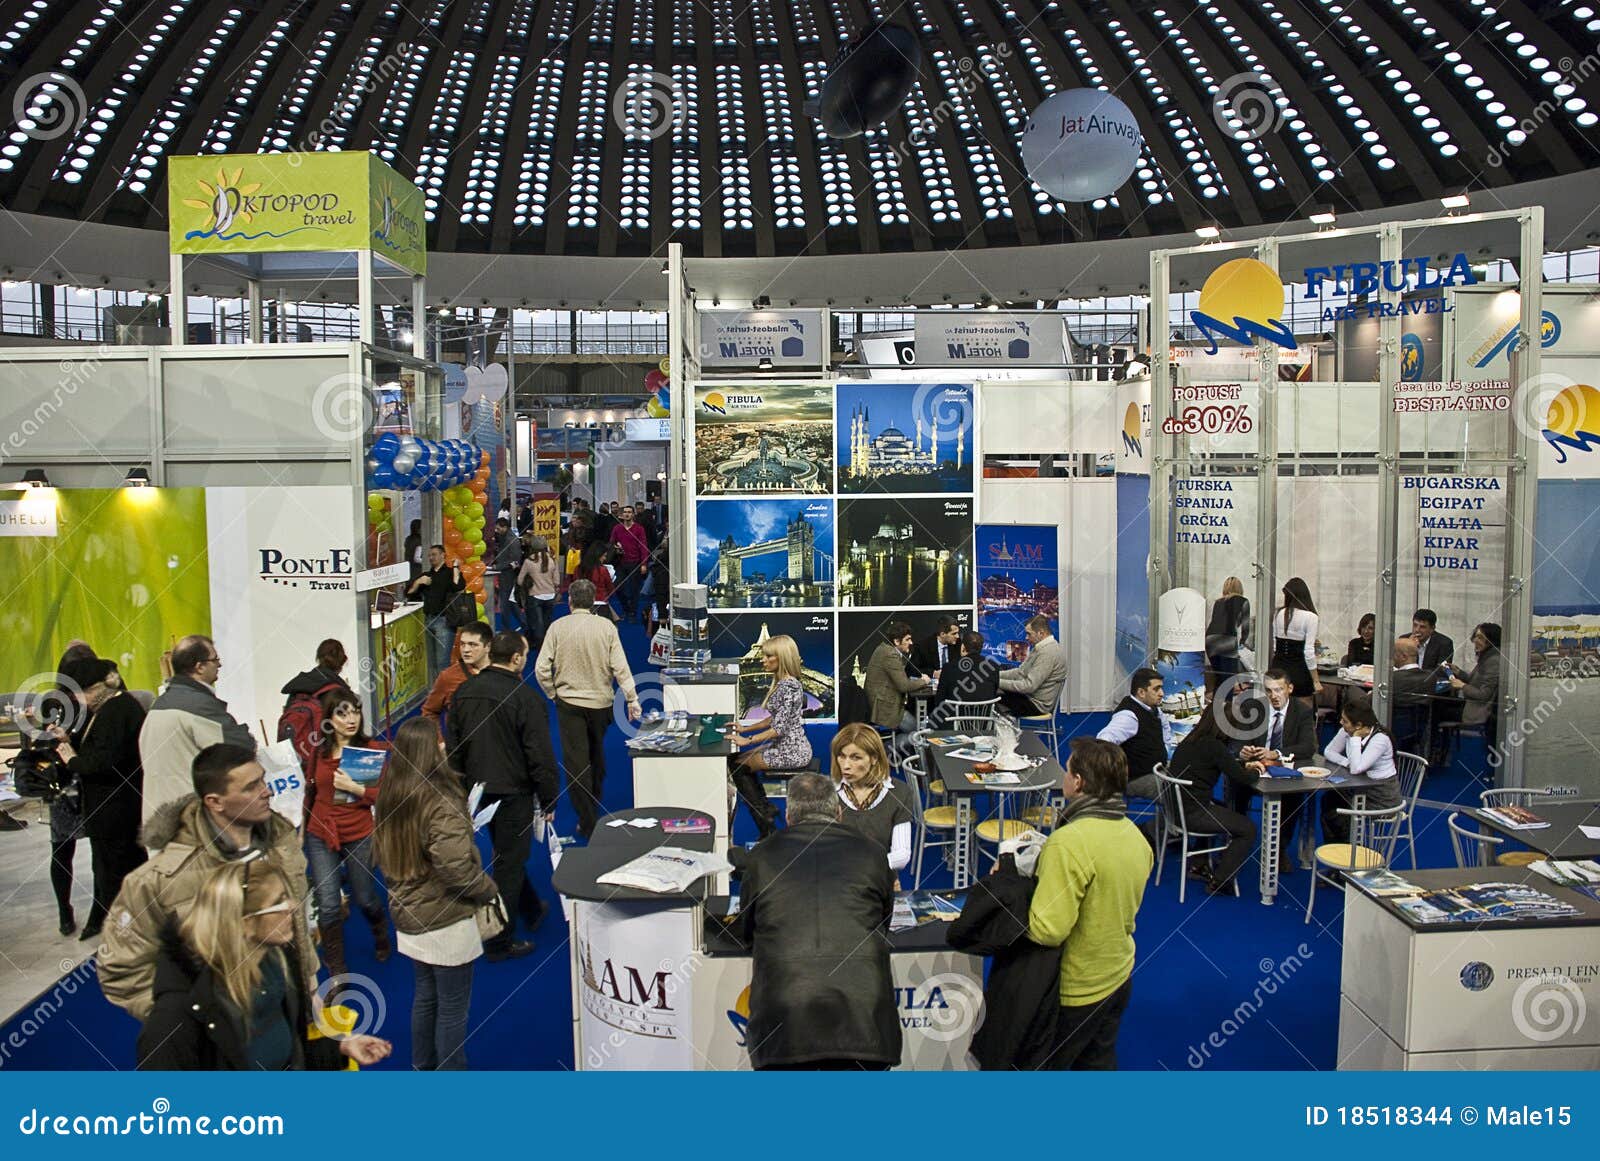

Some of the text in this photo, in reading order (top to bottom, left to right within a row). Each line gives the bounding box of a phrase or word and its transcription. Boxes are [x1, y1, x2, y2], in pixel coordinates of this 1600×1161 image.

[303, 211, 356, 226] travel
[1304, 253, 1477, 299] FIBULA
[1321, 298, 1455, 321] AIR TRAVEL
[1173, 384, 1241, 401] POPUST
[1394, 379, 1510, 394] deca do 15 godina
[727, 395, 762, 403] FIBULA
[1394, 396, 1510, 413] BESPLATNO
[1176, 480, 1233, 491] TURSKA
[1403, 477, 1500, 490] BUGARSKA
[1175, 494, 1233, 509] ŠPANIJA
[1420, 497, 1485, 510] EGIPAT
[537, 520, 557, 531] TOP
[1179, 512, 1229, 527] GRČKA
[1421, 517, 1483, 530] MALTA
[1176, 532, 1232, 545] ITALIJA
[1424, 536, 1479, 550] KIPAR
[1423, 556, 1479, 570] DUBAI
[309, 580, 350, 590] Travel
[1507, 967, 1547, 979] PRESA
[900, 1017, 932, 1028] VEL
[639, 1024, 673, 1036] SPA
